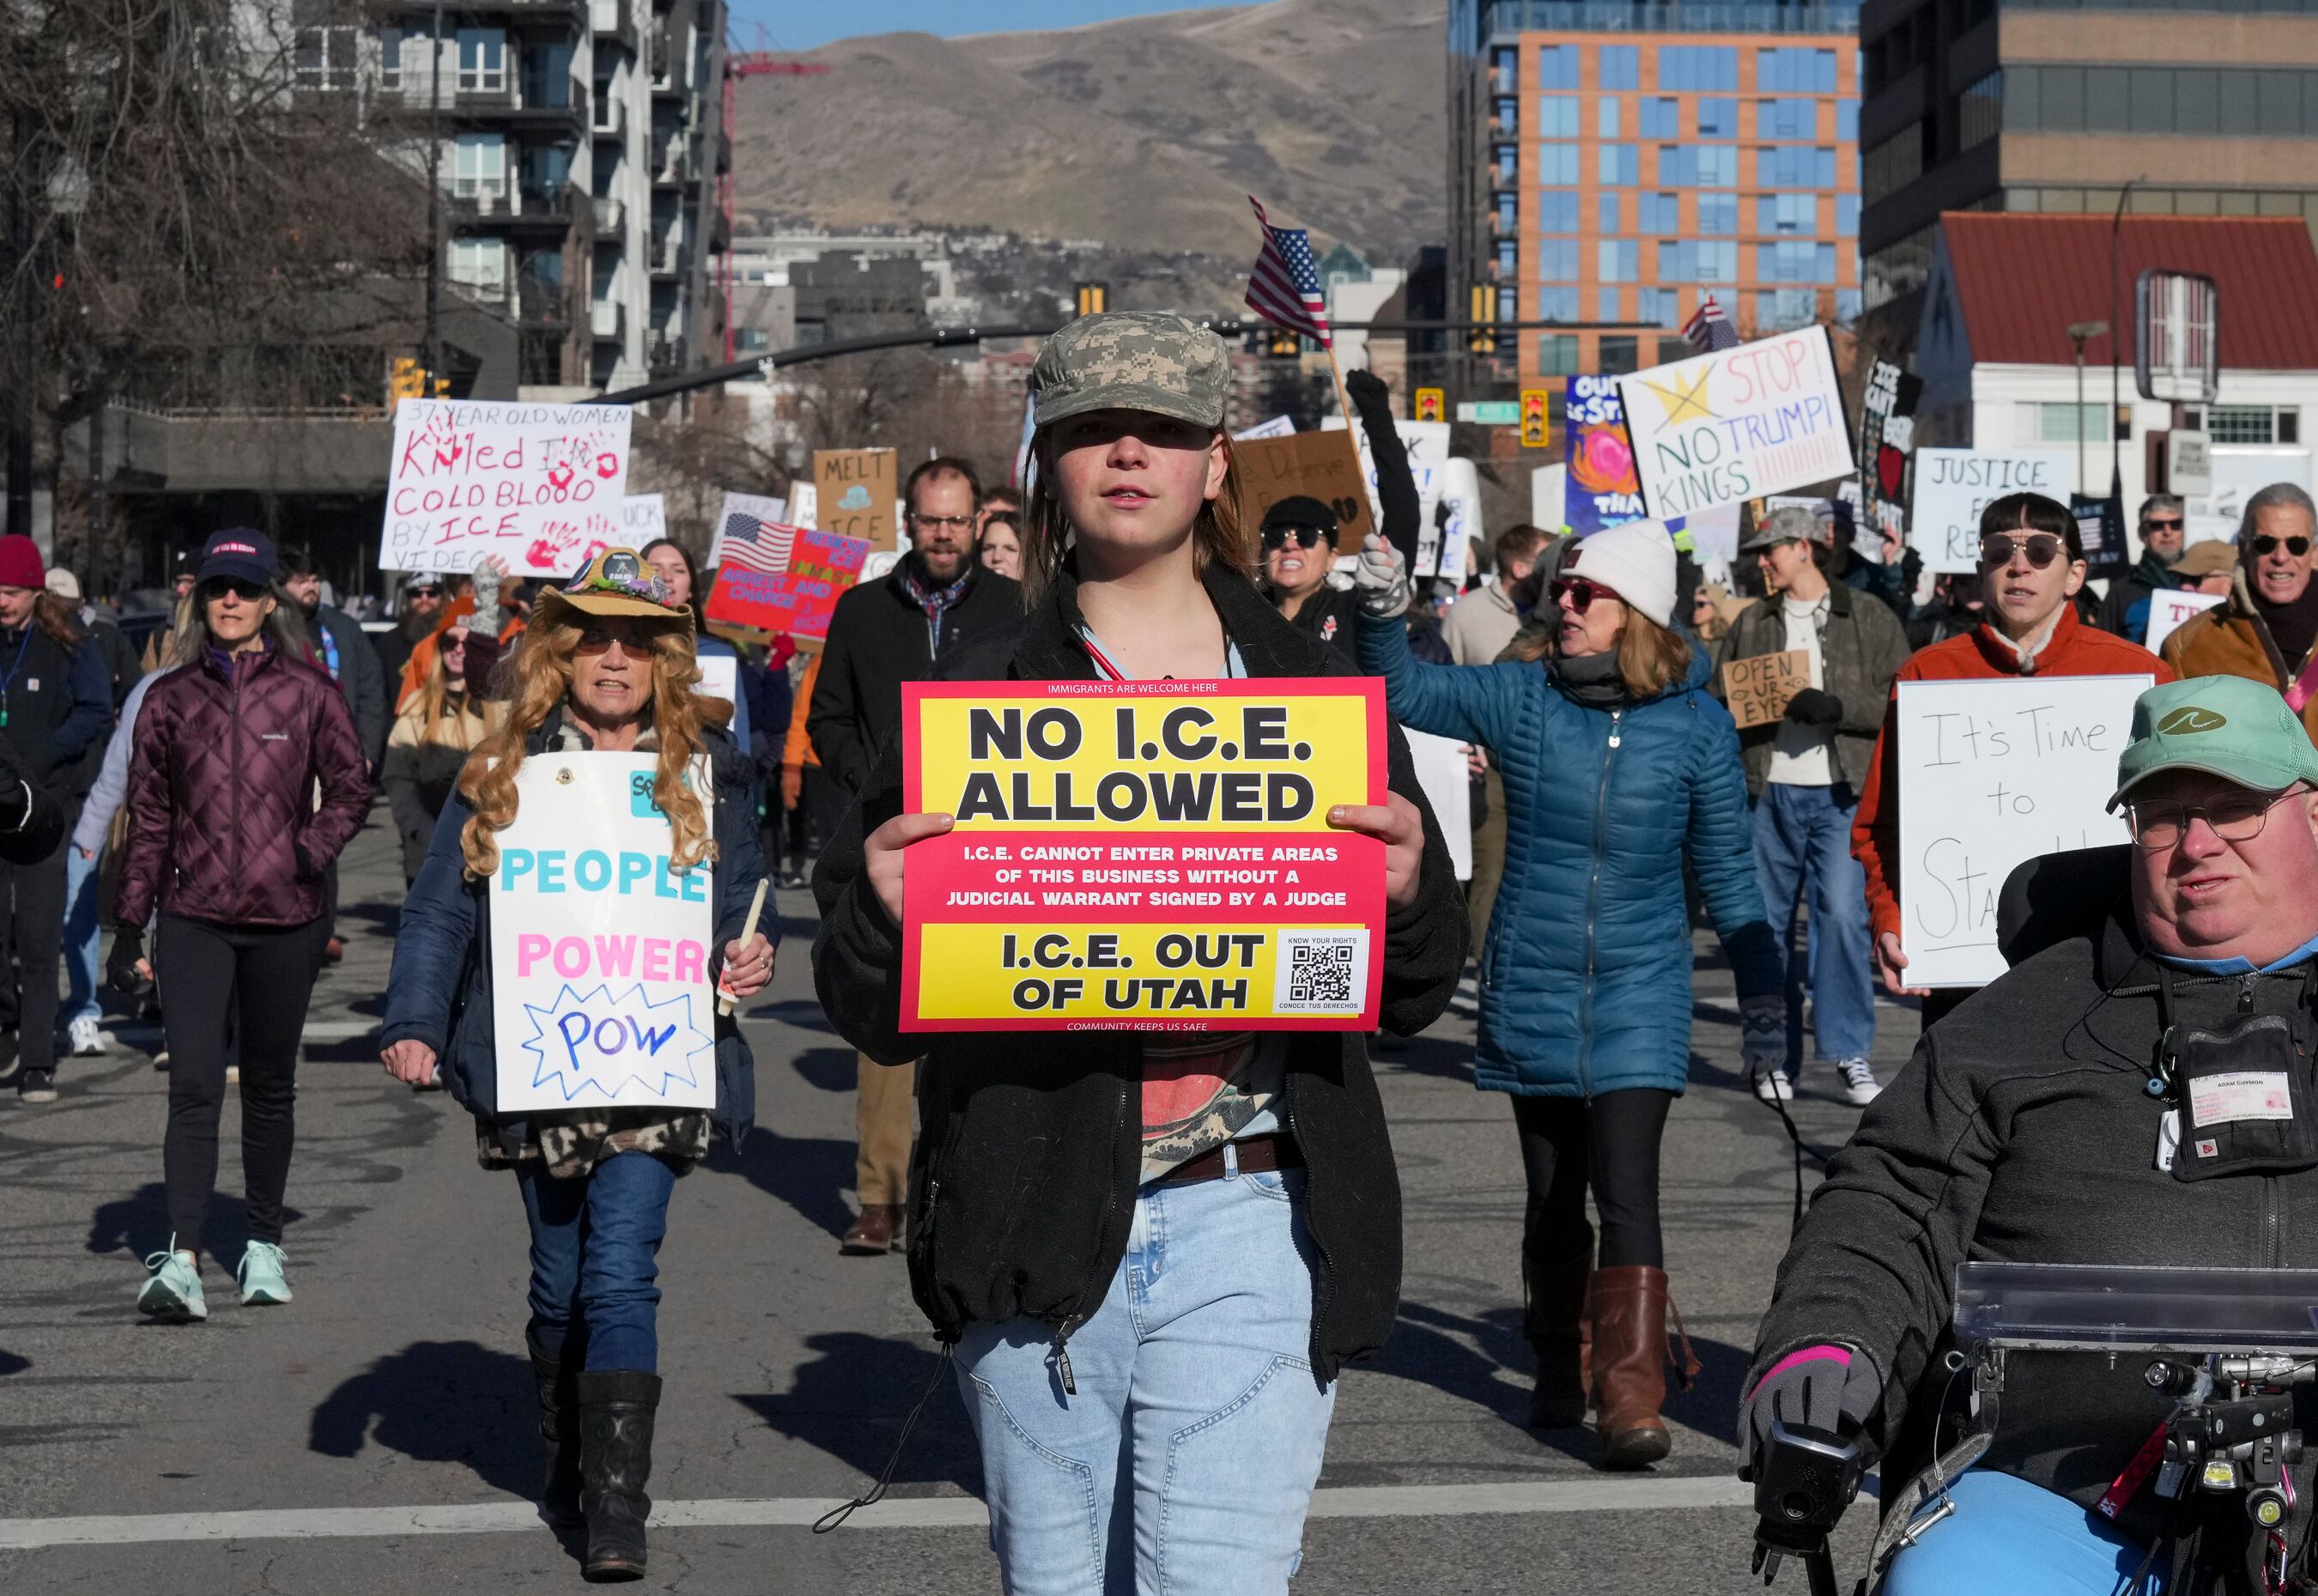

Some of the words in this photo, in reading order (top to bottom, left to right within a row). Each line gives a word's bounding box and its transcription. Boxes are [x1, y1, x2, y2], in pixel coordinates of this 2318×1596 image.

[408, 405, 438, 423] 37
[443, 404, 498, 428] YEAR
[507, 407, 549, 424] OLD
[554, 406, 629, 426] WOMEN
[1656, 427, 1721, 474] NO
[824, 452, 888, 482] MELT
[1932, 457, 2048, 489] JUSTICE
[394, 484, 485, 515] COLD
[495, 479, 595, 508] BLOOD
[1655, 460, 1751, 517] KINGS
[391, 522, 431, 546] BY
[434, 513, 523, 544] ICE
[623, 502, 661, 527] UCK
[1945, 524, 1977, 560] RE
[721, 568, 787, 590] ARREST
[795, 580, 831, 598] AND
[730, 586, 797, 609] CHARGE
[1732, 653, 1793, 683] OPEN
[1048, 684, 1113, 694] IMMIGRANTS
[1117, 684, 1136, 693] ARE
[1138, 683, 1189, 693] WELCOME
[1192, 683, 1218, 692] HERE
[1754, 682, 1782, 697] UR
[968, 707, 1083, 761] NO
[1116, 706, 1312, 761] I.C.E.
[1921, 712, 2011, 768] It's
[956, 771, 1314, 822] ALLOWED
[1987, 781, 2036, 816] to
[963, 847, 1013, 861] I.C.E.
[1020, 847, 1103, 861] CANNOT
[1110, 847, 1175, 861] ENTER
[1181, 847, 1265, 861] PRIVATE
[1271, 847, 1338, 861] AREAS
[501, 848, 706, 903] PEOPLE
[995, 869, 1022, 883] OF
[1029, 869, 1075, 883] THIS
[1082, 869, 1180, 883] BUSINESS
[1186, 869, 1279, 883] WITHOUT
[1284, 869, 1300, 883] A
[946, 891, 1035, 907] JUDICIAL
[1041, 891, 1143, 907] WARRANT
[1149, 891, 1223, 907] SIGNED
[1229, 891, 1256, 907] BY
[1262, 891, 1277, 907] A
[1283, 891, 1347, 907] JUDGE
[518, 933, 705, 985] POWER
[1002, 935, 1133, 969] I.C.E.
[1156, 935, 1265, 968] OUT
[1013, 979, 1082, 1010] OF
[1105, 979, 1247, 1010] UTAH
[557, 1010, 677, 1071] POW
[1067, 1023, 1132, 1031] COMMUNITY
[1133, 1023, 1164, 1031] KEEPS
[1166, 1023, 1180, 1031] US
[1183, 1023, 1208, 1031] SAFE
[2218, 1079, 2236, 1088] ADAM
